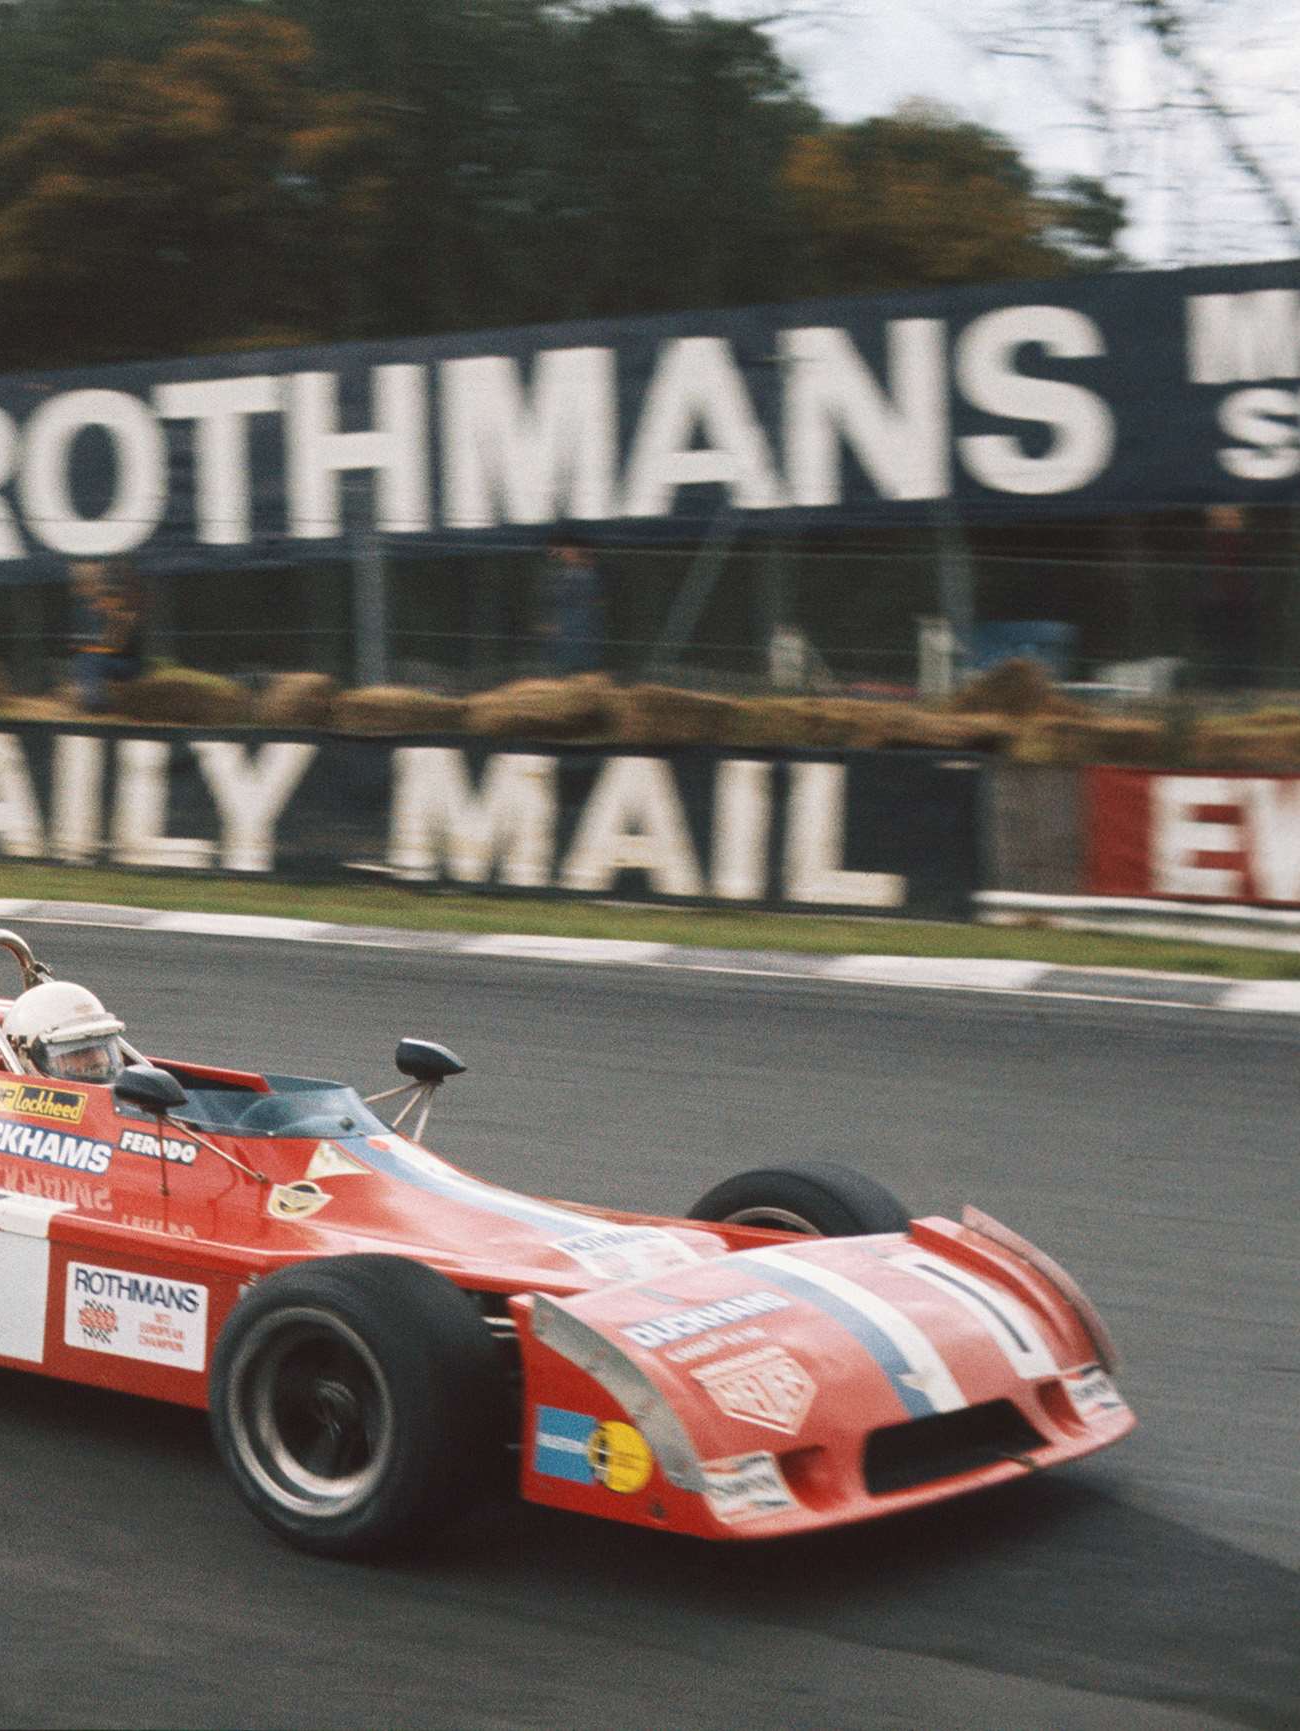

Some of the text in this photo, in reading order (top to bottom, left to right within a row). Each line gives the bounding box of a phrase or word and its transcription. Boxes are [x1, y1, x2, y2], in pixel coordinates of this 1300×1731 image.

[386, 745, 906, 908] MAIL
[15, 1086, 85, 1121] Lockheed
[119, 1130, 198, 1164] FERODO
[74, 1267, 200, 1314] ROTHMANS
[618, 1291, 792, 1349] DUCKHAMS
